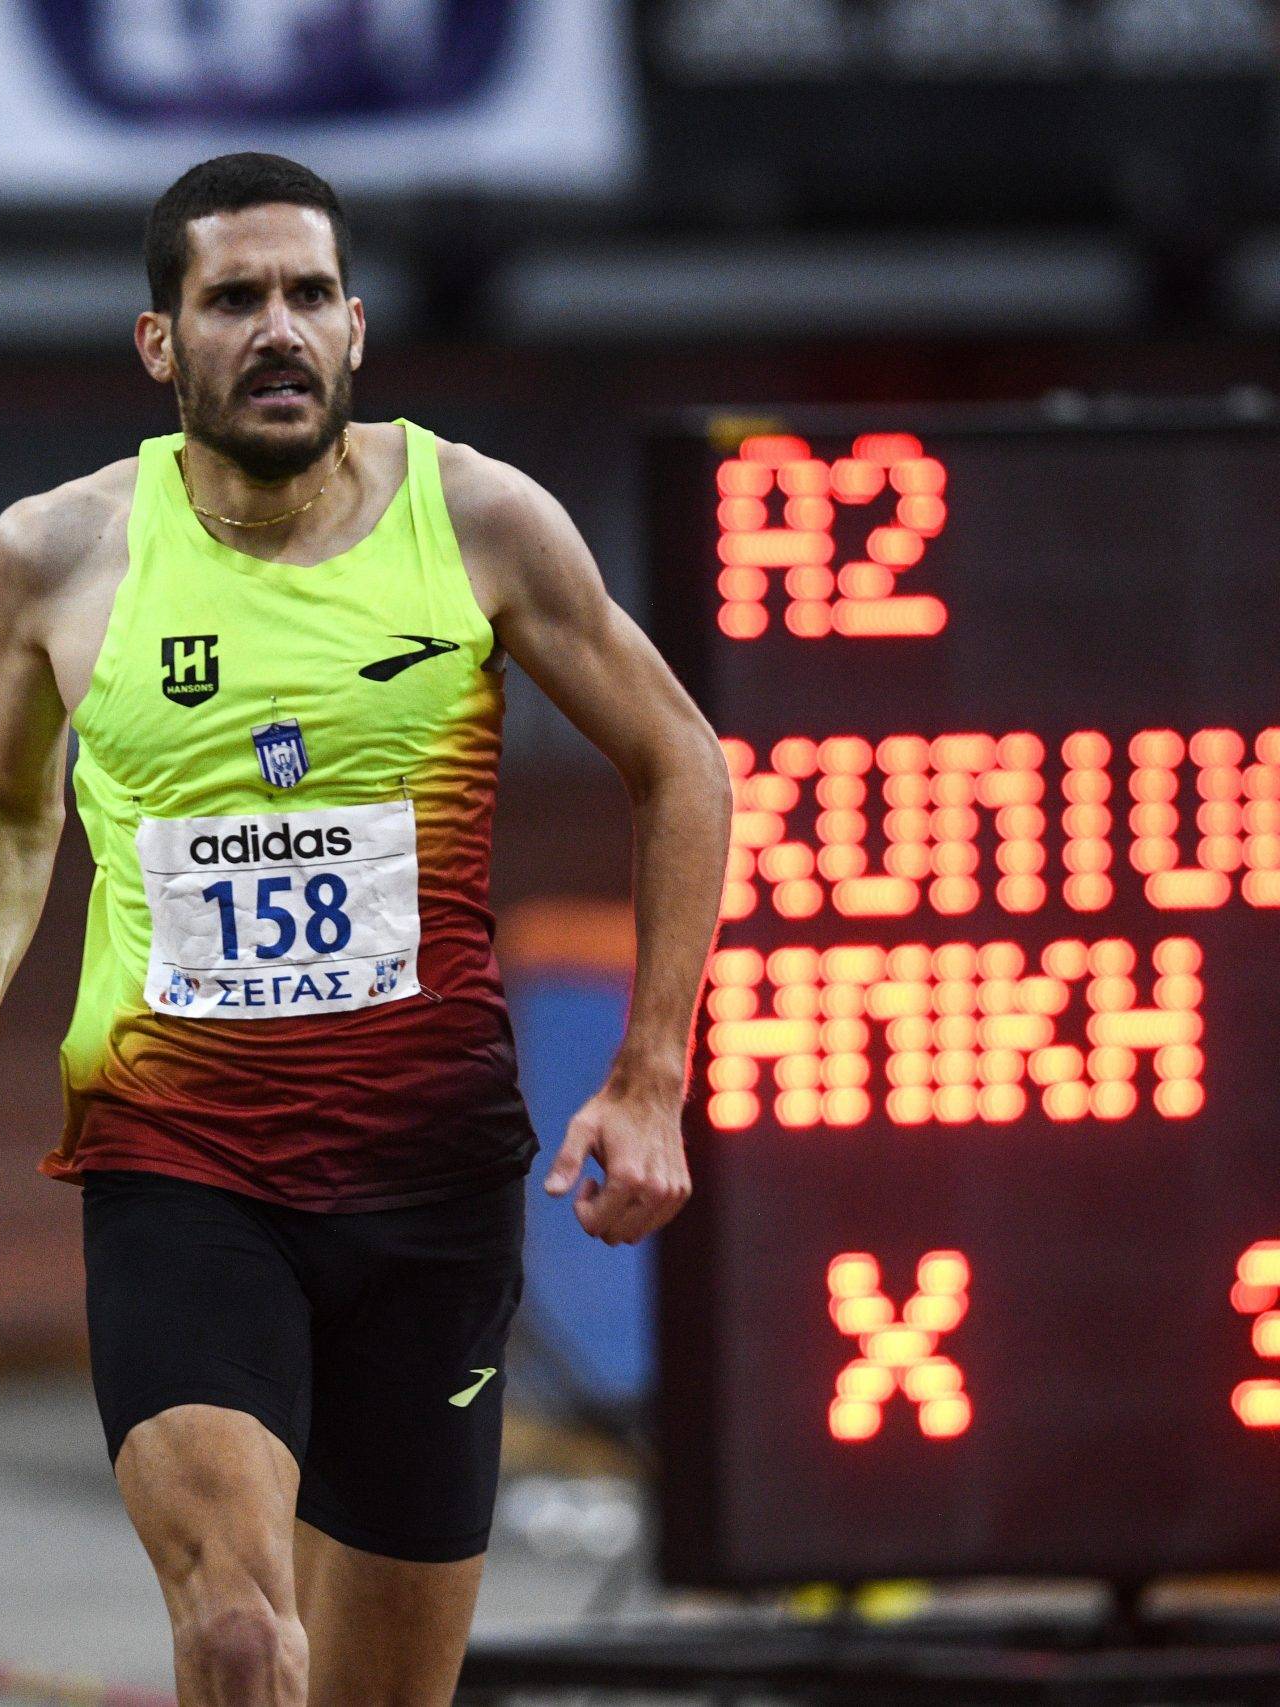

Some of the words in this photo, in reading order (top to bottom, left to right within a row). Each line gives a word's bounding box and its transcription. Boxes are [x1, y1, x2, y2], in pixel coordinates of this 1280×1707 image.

[716, 433, 948, 640] A2
[166, 683, 214, 694] HANSONS
[190, 822, 352, 865] adidas
[202, 873, 351, 960] 158
[215, 970, 353, 1006] ΣΕΓΑΣ
[826, 1248, 972, 1441] X
